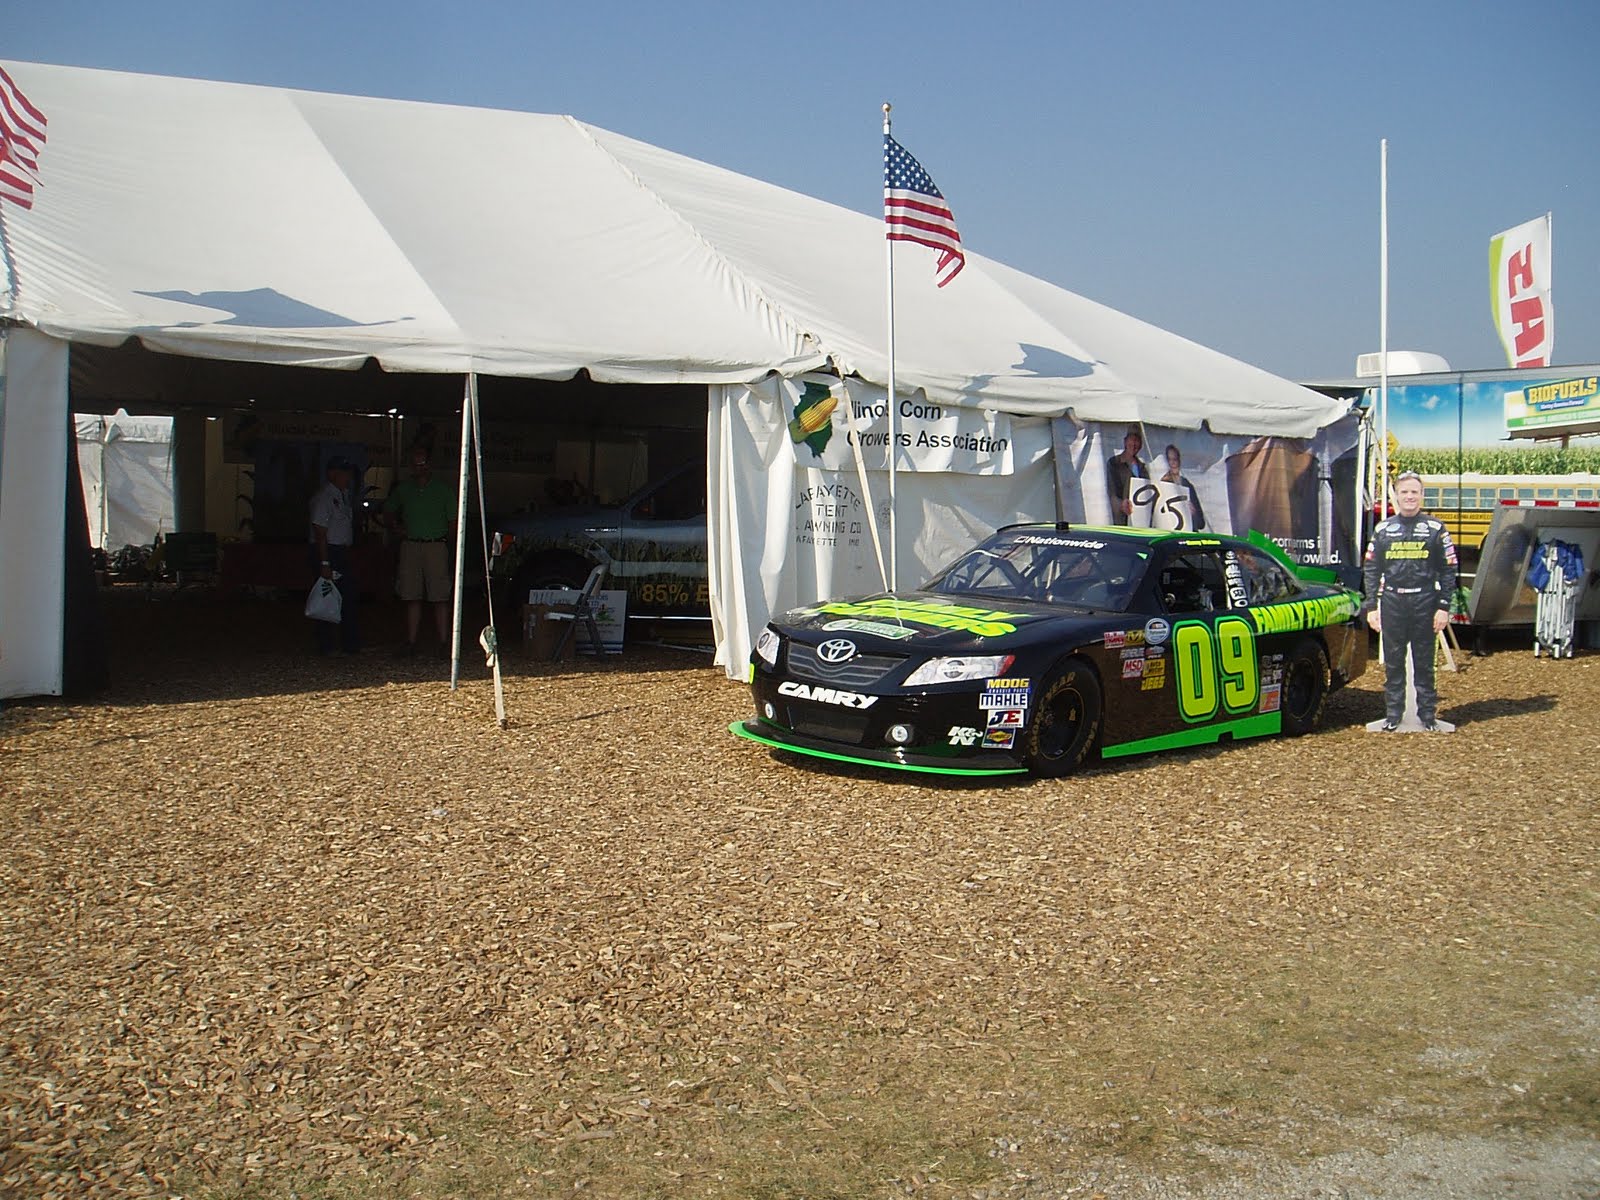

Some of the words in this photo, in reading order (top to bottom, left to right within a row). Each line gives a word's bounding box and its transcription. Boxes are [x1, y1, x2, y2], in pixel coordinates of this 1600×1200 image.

[1528, 377, 1597, 404] BIOFUELS
[900, 400, 941, 419] Corn
[1025, 535, 1104, 550] Nationwide
[641, 583, 689, 603] 85%
[1247, 600, 1305, 635] FAMILY
[1124, 660, 1143, 672] MSD
[1173, 615, 1260, 724] 09
[986, 678, 1030, 689] MOOG
[777, 681, 879, 709] CAMRY
[981, 694, 1026, 706] MAHLE
[989, 710, 1021, 726] JE
